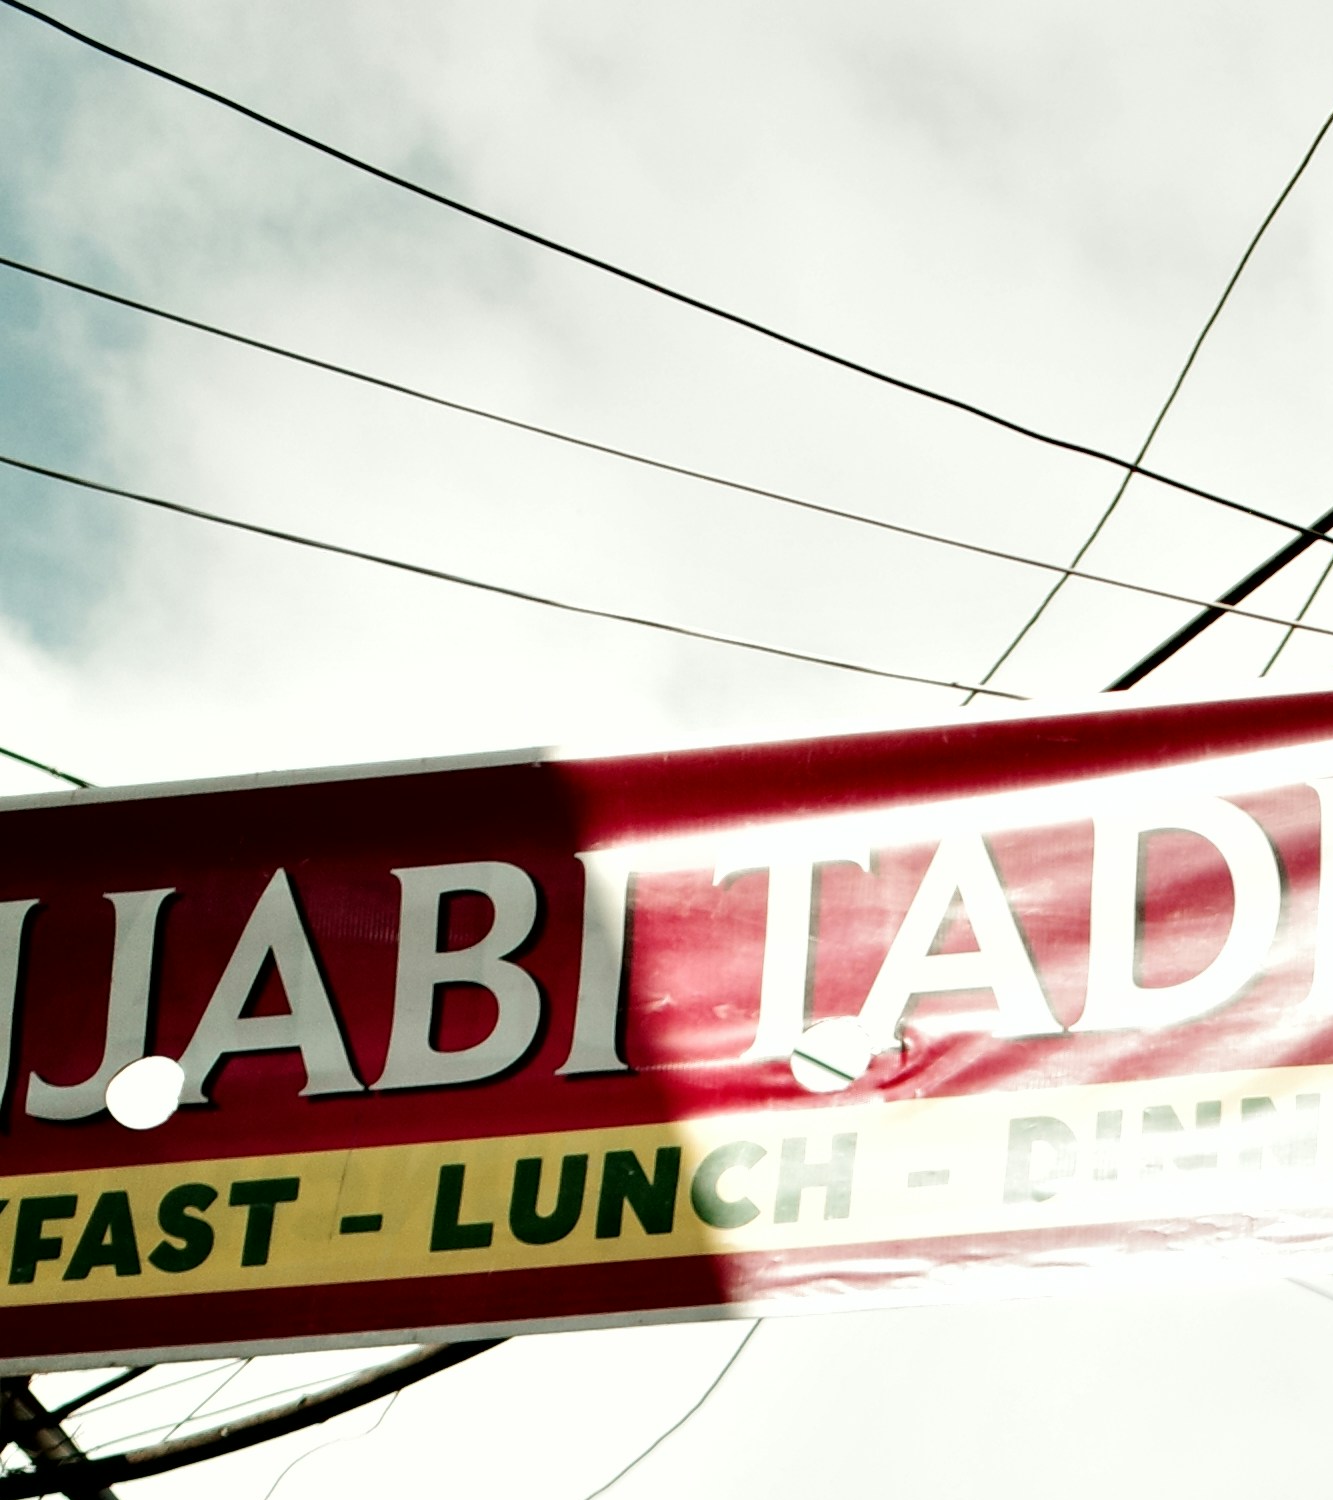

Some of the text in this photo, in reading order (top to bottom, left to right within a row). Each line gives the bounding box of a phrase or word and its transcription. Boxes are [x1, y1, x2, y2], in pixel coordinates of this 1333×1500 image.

[0, 852, 628, 1122] JABI
[0, 1177, 300, 1285] FAST
[430, 1131, 858, 1252] LUNCH
